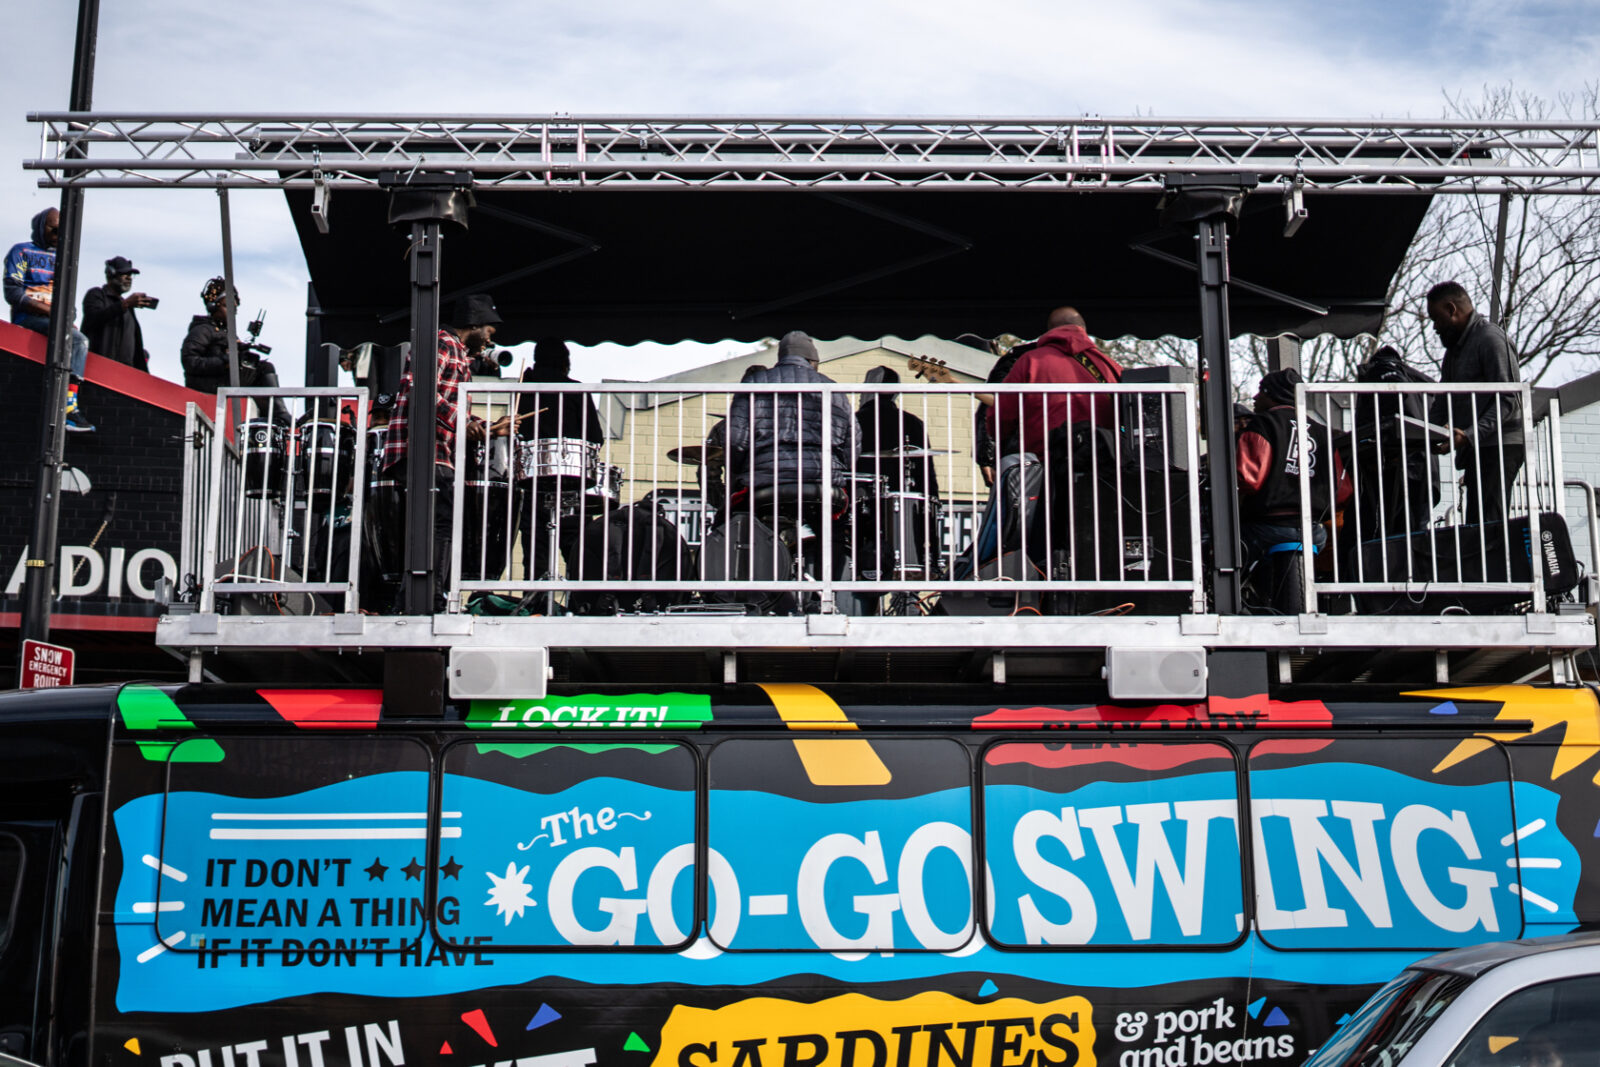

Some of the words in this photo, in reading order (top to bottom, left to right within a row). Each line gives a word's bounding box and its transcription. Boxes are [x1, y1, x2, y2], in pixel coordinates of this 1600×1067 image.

[1544, 541, 1560, 576] YAMAHA
[28, 660, 68, 677] EMERGENCY
[34, 646, 63, 665] SNOW
[33, 673, 61, 688] ROUTE
[491, 705, 609, 728] LOCK
[615, 705, 669, 728] IT!
[541, 806, 618, 848] The
[205, 858, 236, 888] IT
[245, 858, 351, 888] DON'T
[547, 821, 995, 962] GO-GO
[1013, 798, 1500, 946] SWING
[201, 898, 308, 927] MEAN
[317, 898, 342, 927] A
[350, 896, 461, 926] THING
[198, 938, 231, 969] IF
[240, 938, 272, 967] IT
[281, 937, 390, 967] DON'T
[401, 936, 494, 967] HAVE
[1114, 1011, 1149, 1042] &
[1153, 998, 1236, 1043] pork
[160, 1039, 268, 1067] UT
[344, 1020, 406, 1067] IN
[1119, 1036, 1188, 1067] and
[1193, 1034, 1295, 1066] beans
